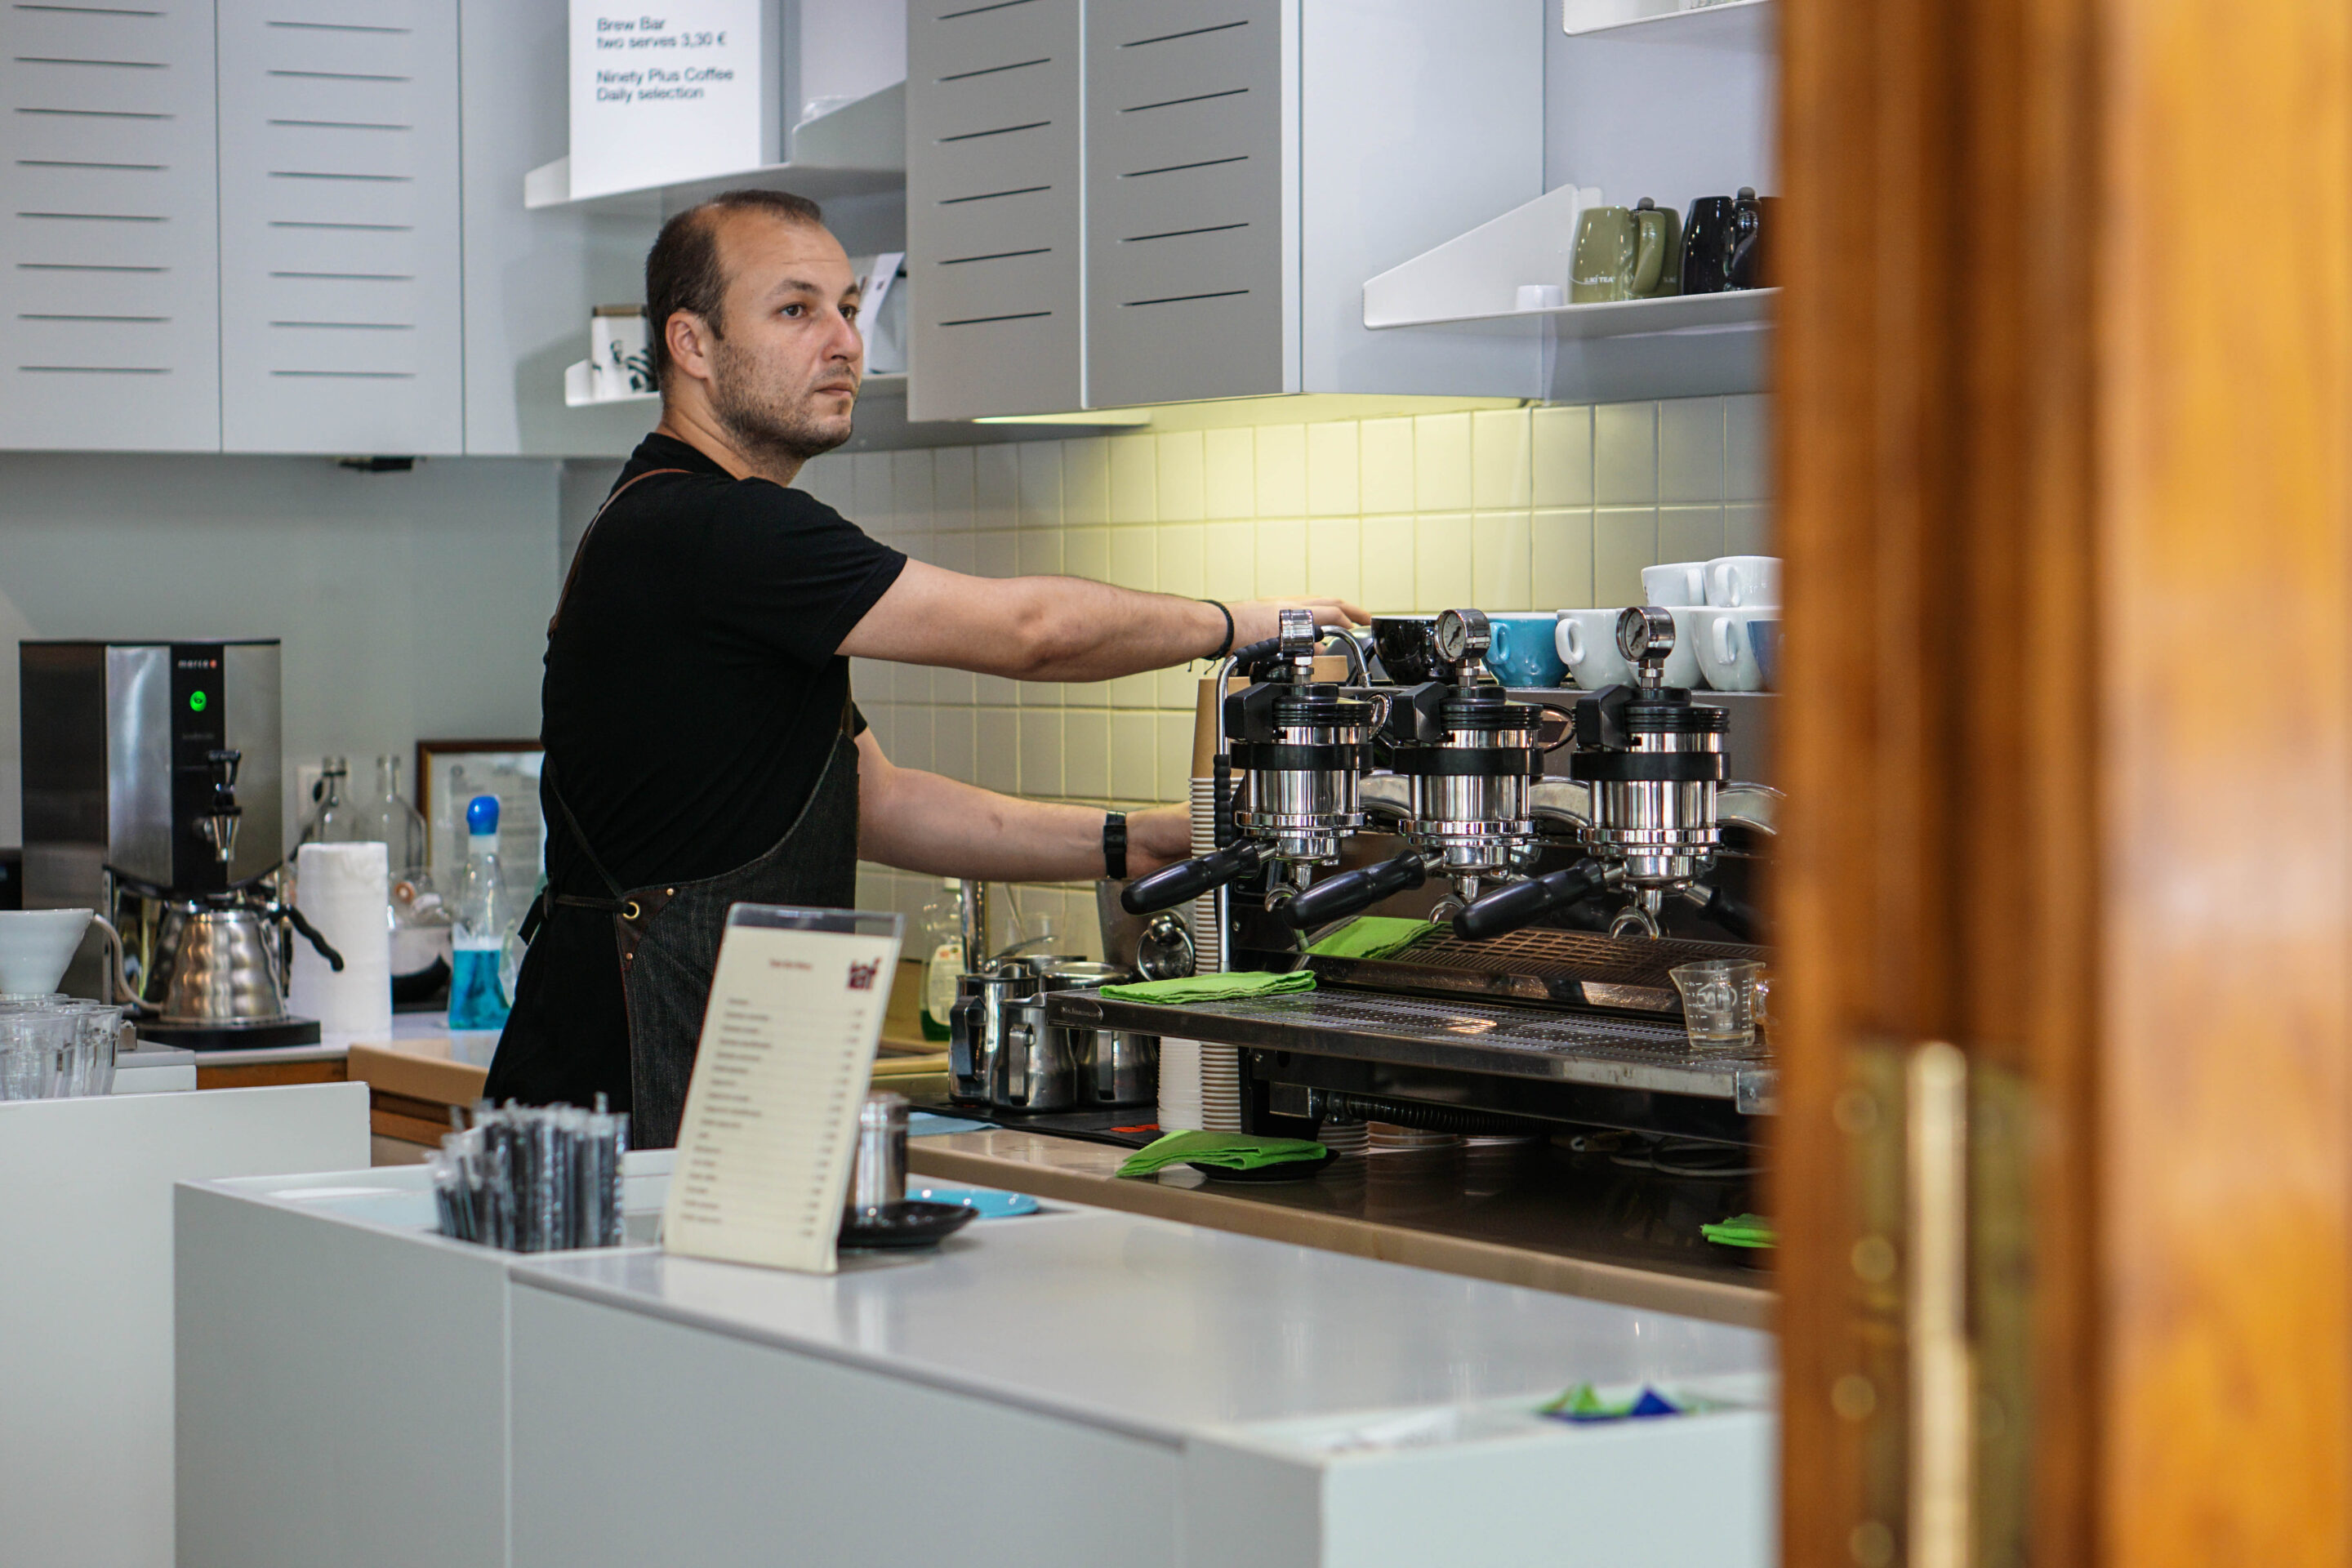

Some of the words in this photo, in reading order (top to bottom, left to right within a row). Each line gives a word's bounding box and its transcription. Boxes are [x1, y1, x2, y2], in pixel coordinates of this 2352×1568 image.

[597, 17, 635, 33] Brew
[639, 16, 666, 31] Bar
[597, 37, 625, 49] two
[629, 36, 678, 49] serves
[681, 32, 713, 48] 3,30
[716, 31, 728, 47] €
[596, 70, 644, 87] Ninety
[648, 68, 680, 82] Plus
[684, 67, 734, 82] Coffee
[596, 87, 633, 105] Daily
[638, 87, 704, 101] selection
